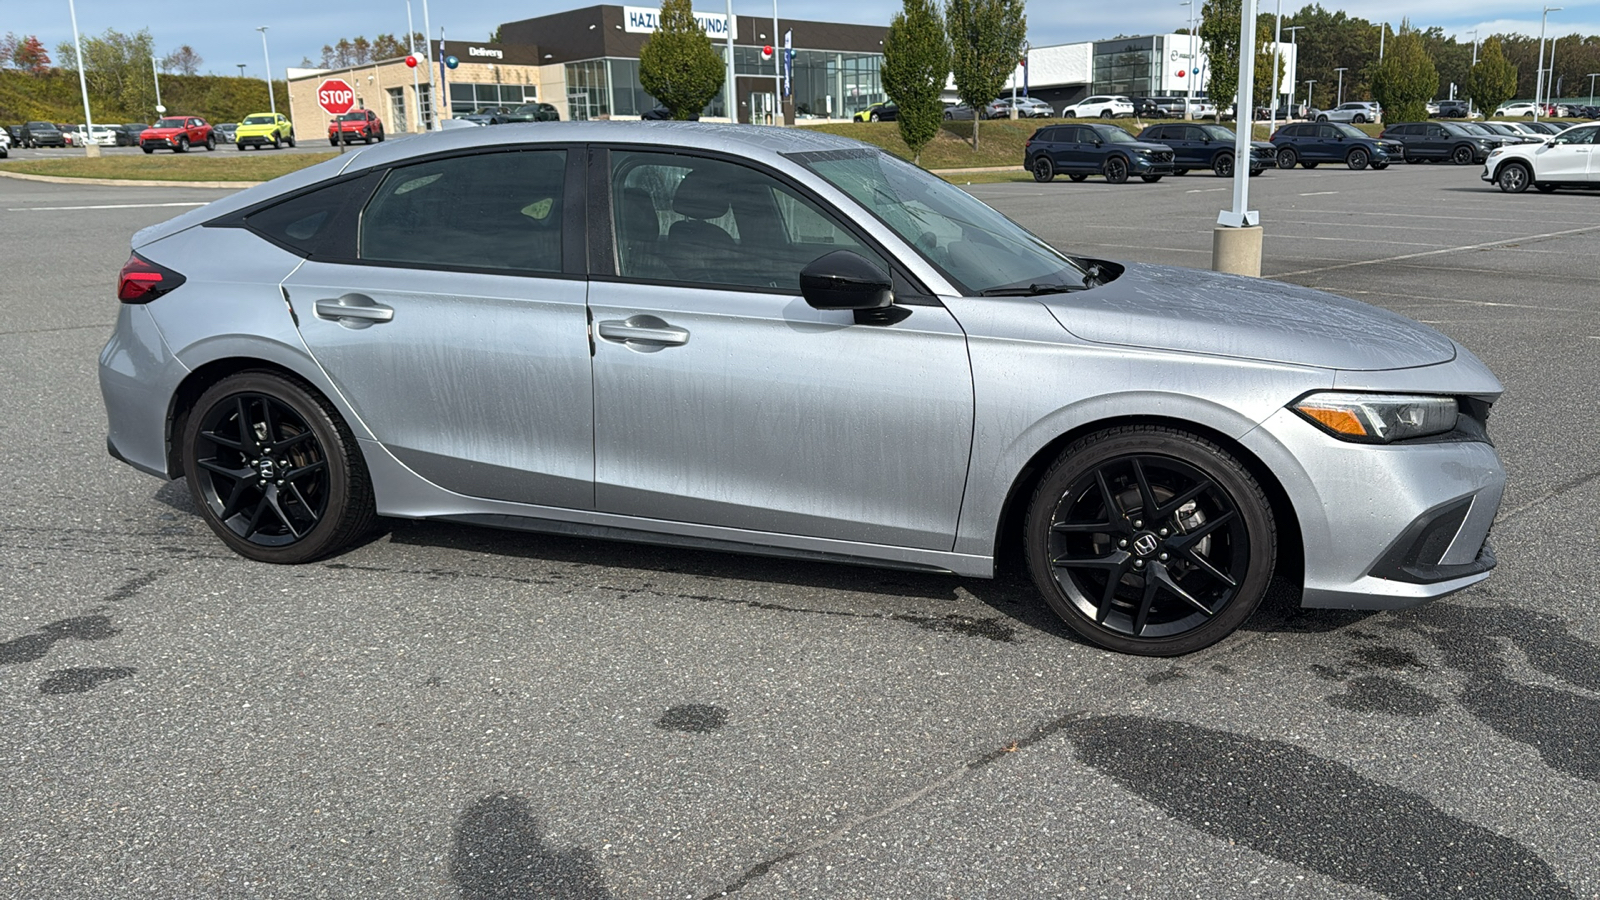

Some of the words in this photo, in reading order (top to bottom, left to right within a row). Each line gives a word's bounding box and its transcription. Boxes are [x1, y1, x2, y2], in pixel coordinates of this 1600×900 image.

[629, 12, 682, 31] HAZL
[685, 16, 731, 33] YUNDA
[469, 46, 503, 59] Delivery
[320, 90, 352, 104] STOP
